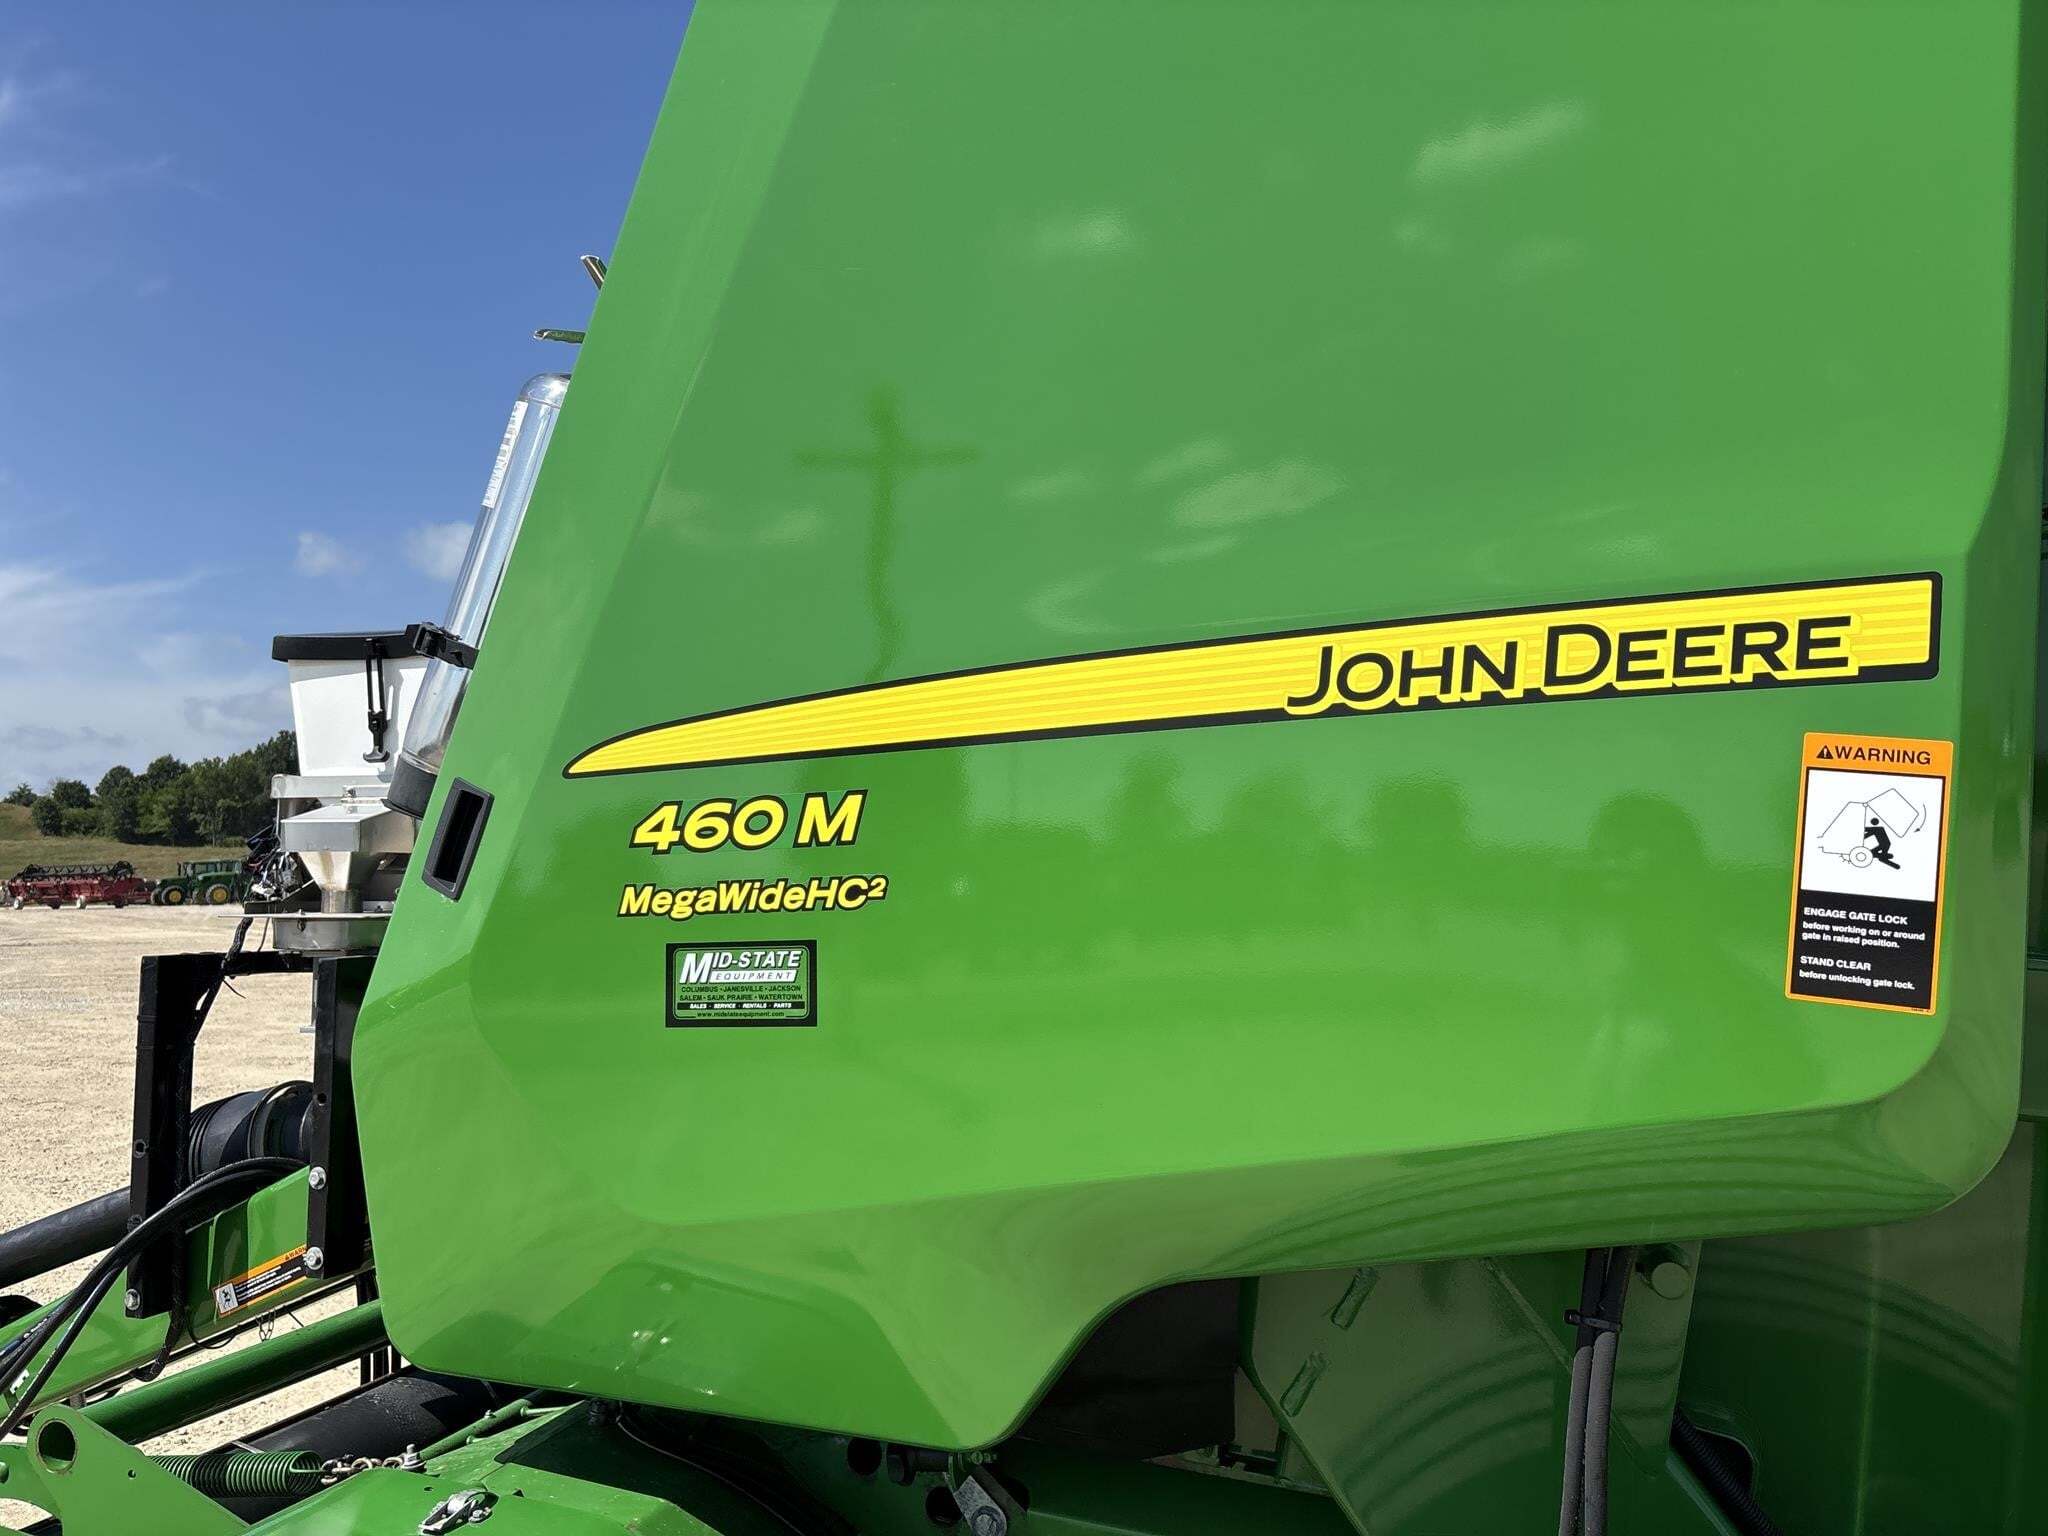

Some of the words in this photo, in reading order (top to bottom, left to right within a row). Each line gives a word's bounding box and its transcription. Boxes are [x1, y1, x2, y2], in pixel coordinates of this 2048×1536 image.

[1286, 641, 1519, 705] JOHN
[1543, 615, 1852, 688] DEERE
[1834, 745, 1931, 765] WARNING
[631, 796, 787, 853] 460
[795, 791, 866, 847] M
[1803, 907, 1846, 919] ENGAGE
[1849, 911, 1876, 922] GATE
[1878, 914, 1908, 925] LOCK
[1802, 921, 1831, 931] before
[1832, 924, 1866, 936] working
[1868, 928, 1880, 936] on
[1882, 930, 1891, 938] or
[1893, 931, 1925, 941] around
[1802, 931, 1821, 941] gate
[1822, 933, 1831, 941] in
[1833, 935, 1860, 944] raised
[1861, 937, 1900, 948] position.
[679, 950, 802, 984] MID-STATE
[1800, 956, 1834, 967] STAND
[1836, 959, 1872, 971] CLEAR
[715, 972, 792, 981] EQUIPMENT
[1799, 970, 1827, 980] before
[1828, 973, 1871, 986] unlocking
[1873, 978, 1892, 988] gate
[1894, 980, 1915, 990] lock.
[681, 985, 719, 993] COLUMBUS
[723, 985, 763, 993] JANESVILLE
[758, 993, 803, 1001] WATERTOWN
